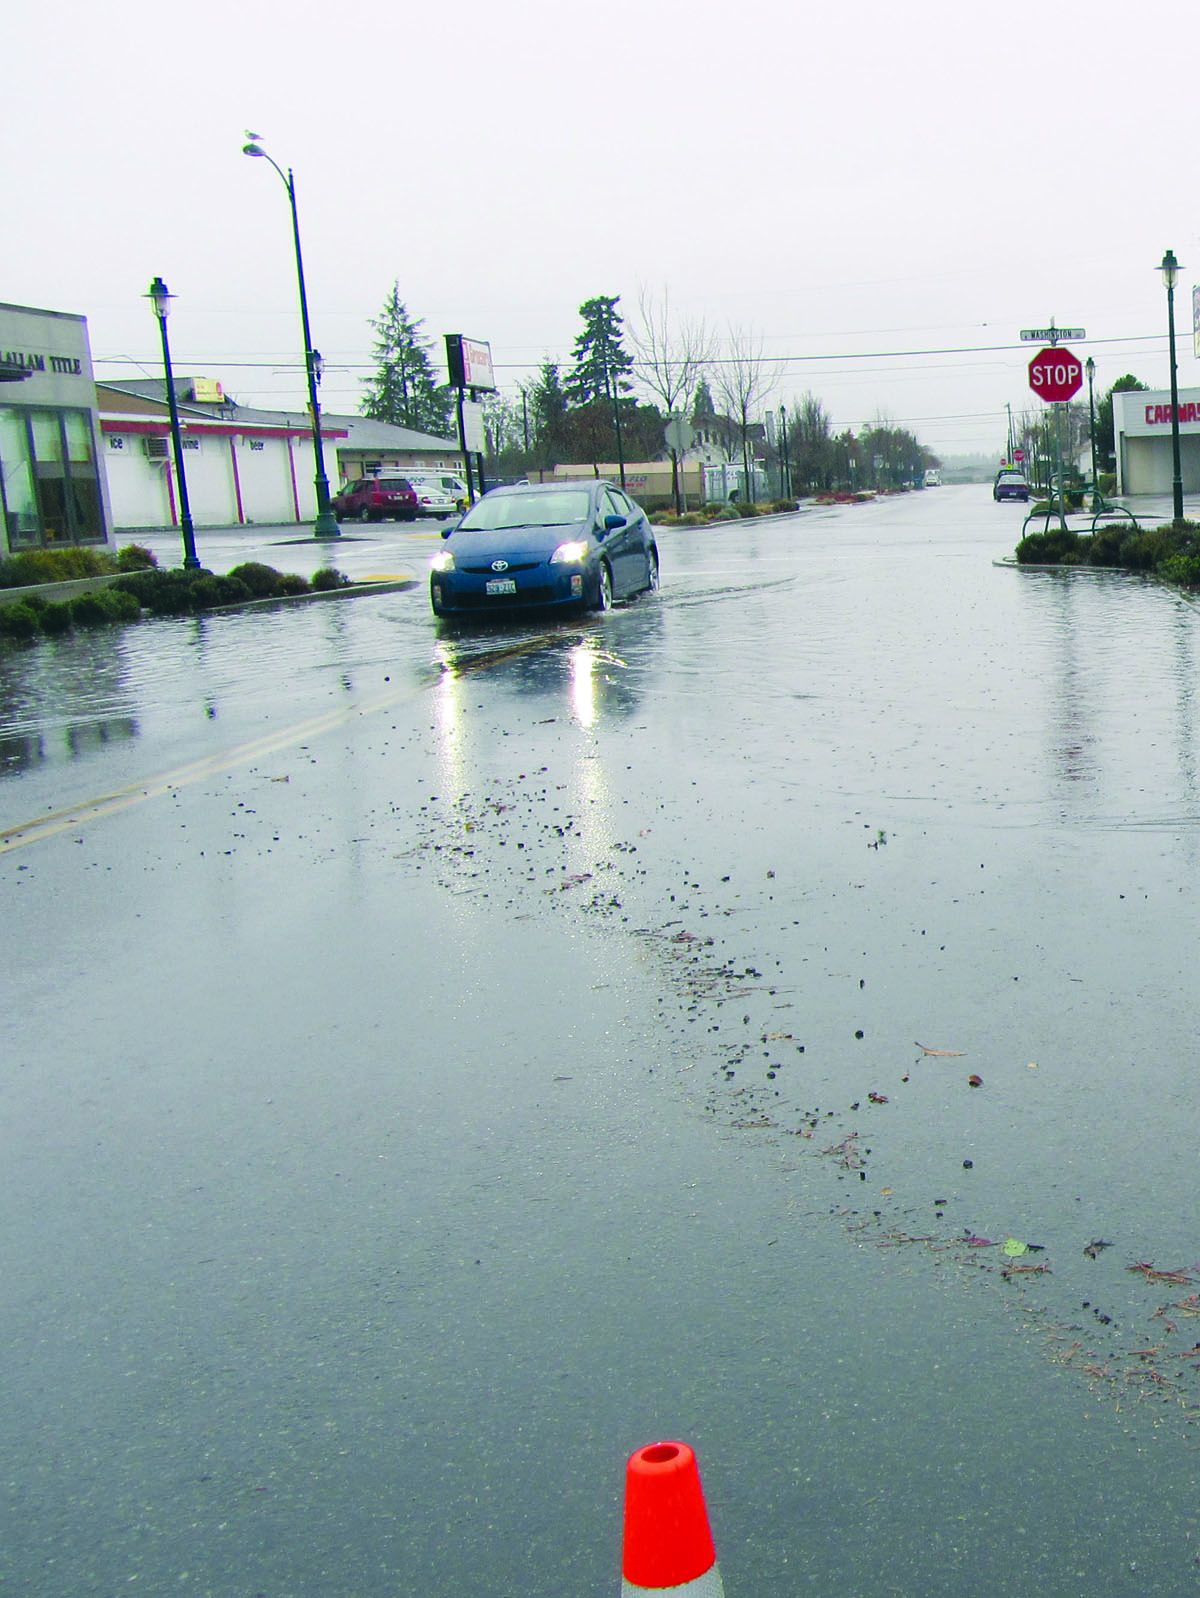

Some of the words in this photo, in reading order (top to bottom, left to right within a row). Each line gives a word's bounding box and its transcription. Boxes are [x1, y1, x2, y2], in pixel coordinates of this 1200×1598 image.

[1030, 330, 1072, 339] WASHINGTON
[49, 355, 82, 375] TITLE
[1032, 364, 1079, 386] STOP
[1145, 404, 1174, 425] CAR
[110, 435, 123, 450] ice
[182, 436, 199, 450] wine
[250, 439, 264, 451] beer
